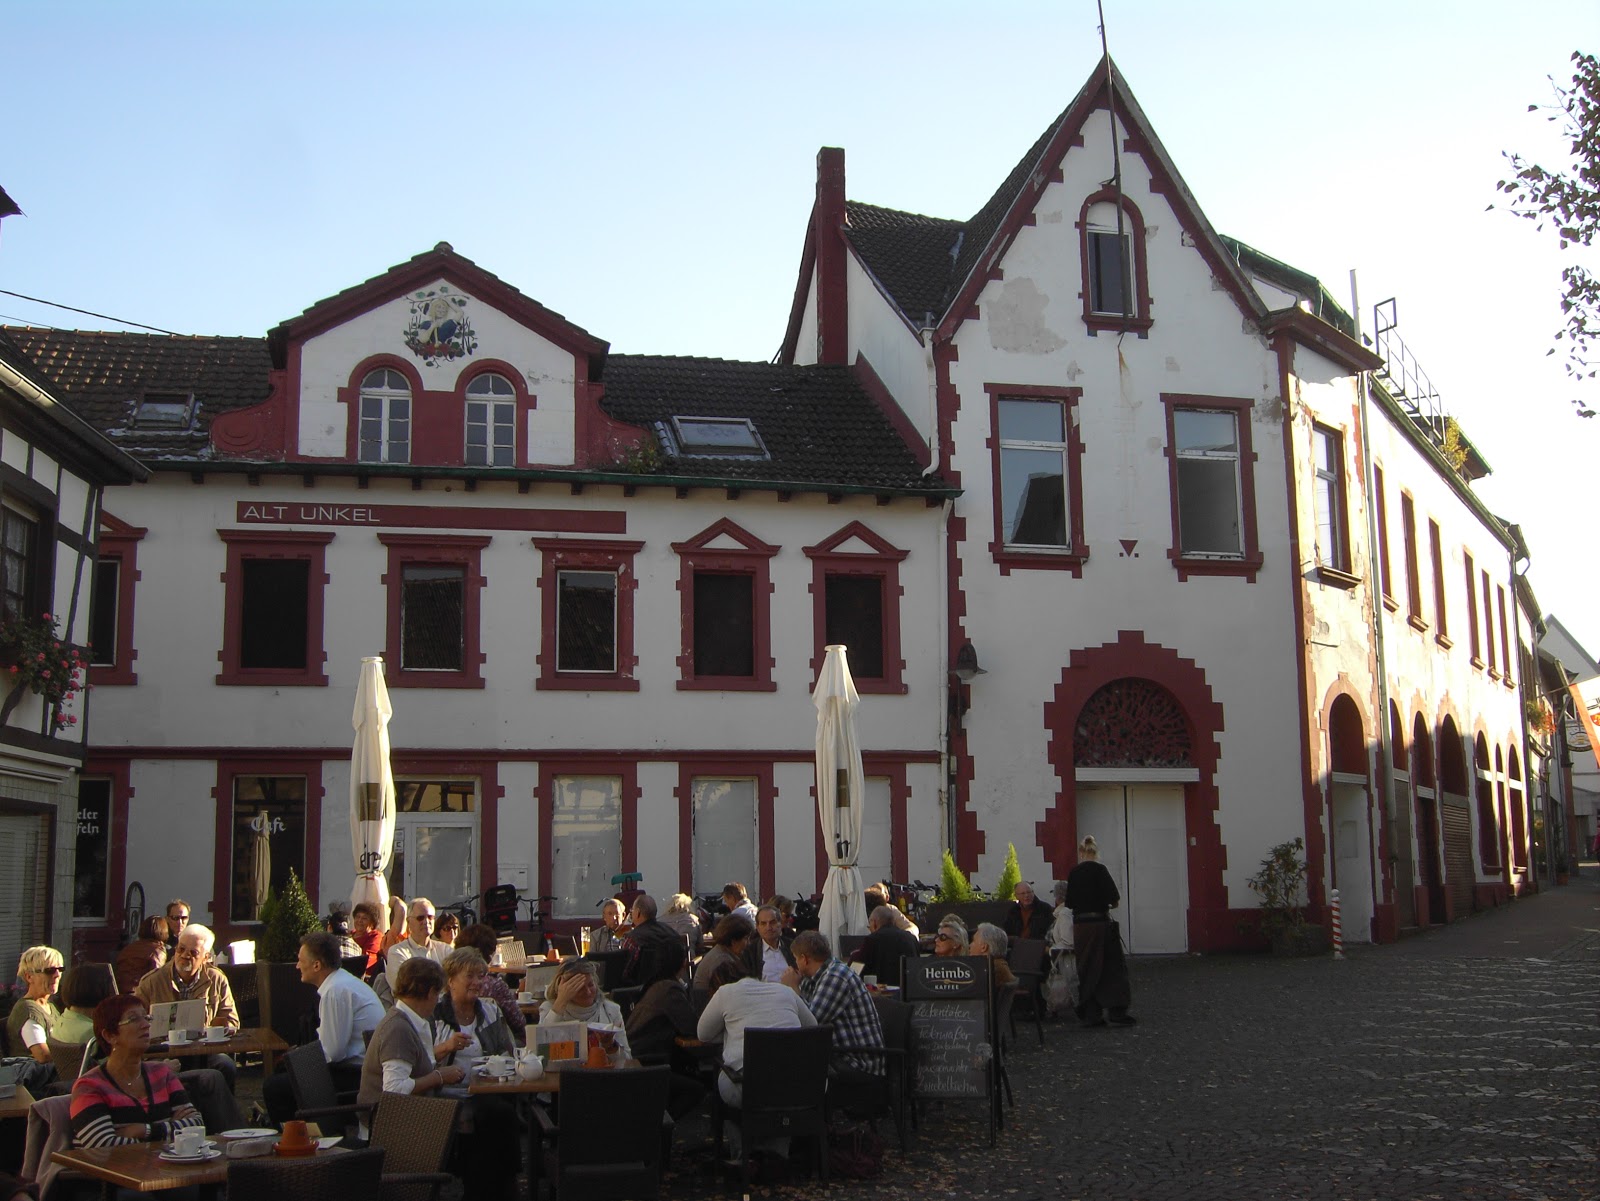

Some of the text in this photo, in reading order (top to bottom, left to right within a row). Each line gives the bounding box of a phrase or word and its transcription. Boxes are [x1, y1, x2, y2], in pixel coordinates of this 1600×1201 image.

[243, 505, 381, 522] ALT UNKEL
[251, 816, 287, 835] Cafe
[925, 966, 971, 979] Heimbs
